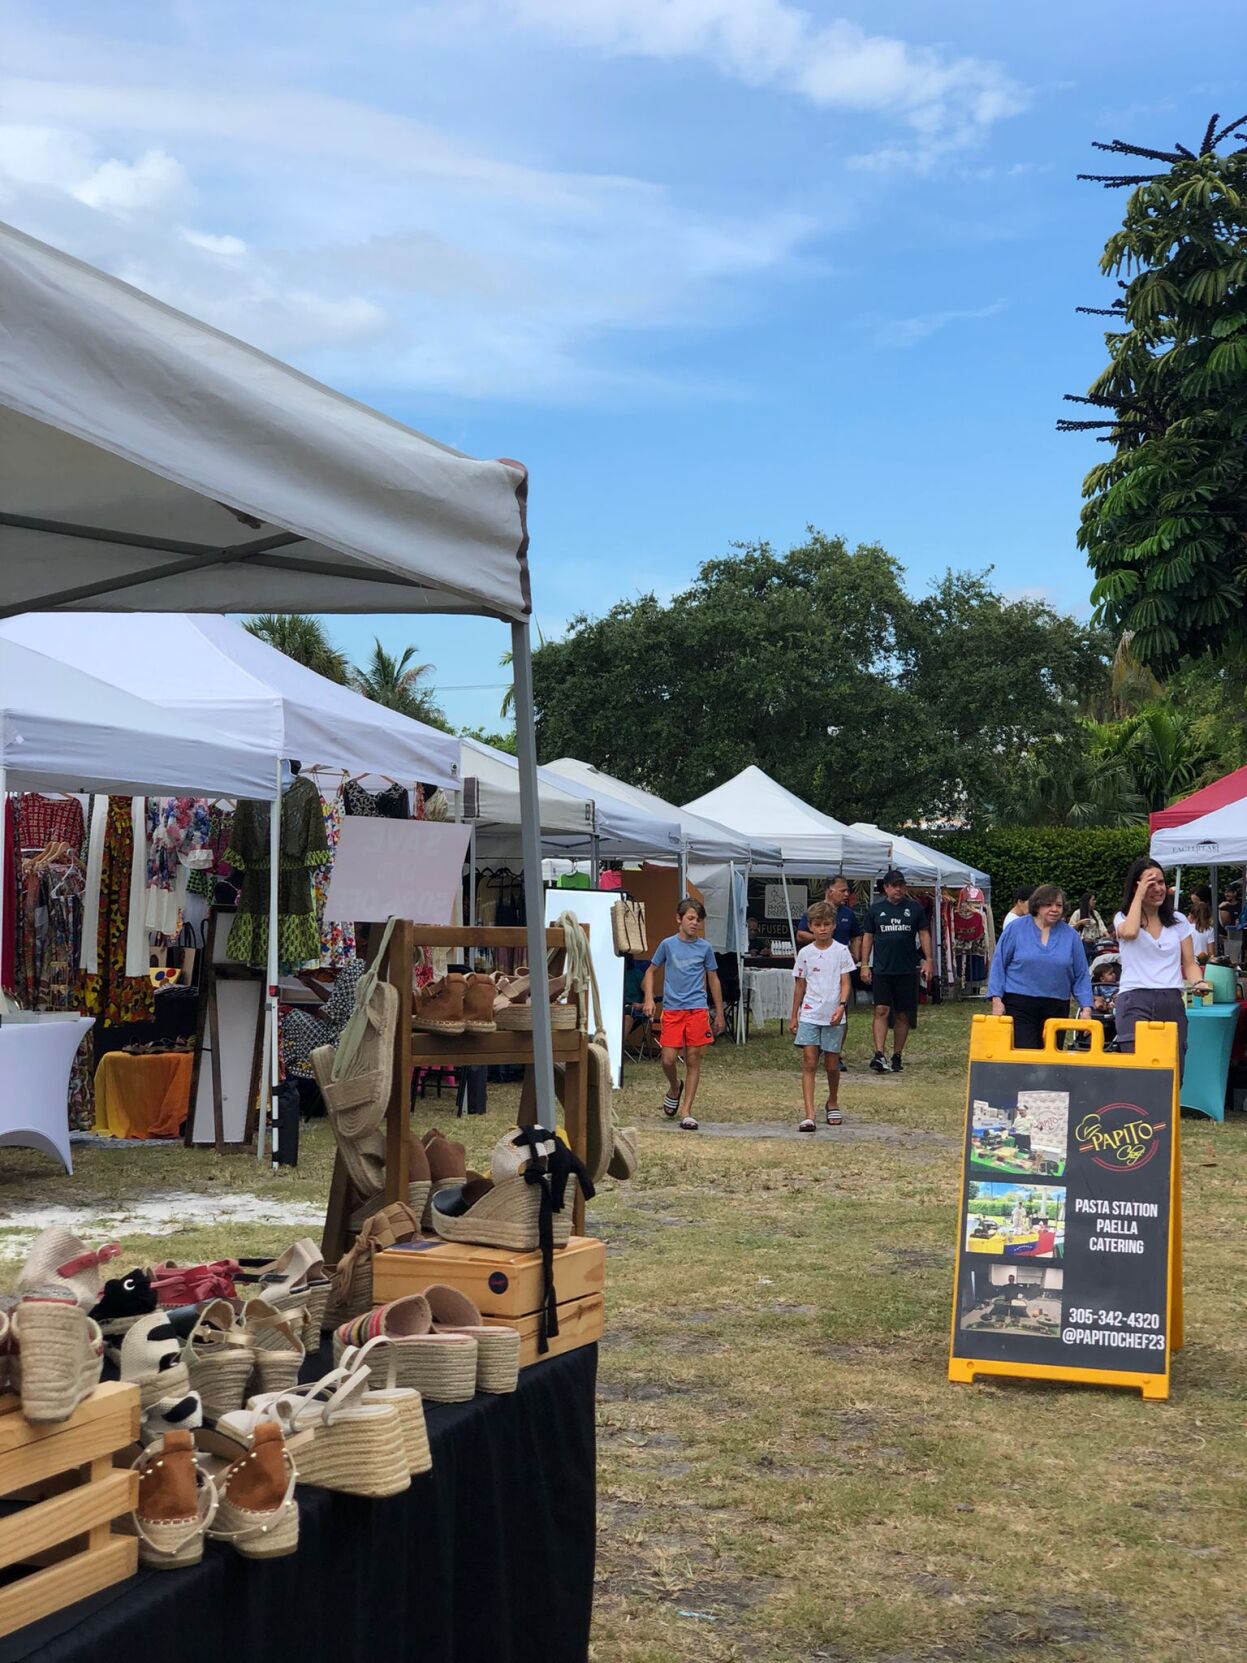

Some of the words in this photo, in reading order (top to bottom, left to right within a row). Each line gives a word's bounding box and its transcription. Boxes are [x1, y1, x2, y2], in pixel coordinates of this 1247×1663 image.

[880, 922, 911, 932] Emirates
[1092, 1120, 1153, 1151] PAPITO
[1075, 1198, 1110, 1214] PASTA
[1112, 1200, 1158, 1218] STATION
[1096, 1218, 1138, 1235] PAELLA
[1089, 1236, 1144, 1254] CATERING
[1069, 1307, 1160, 1329] 305-342-4320
[1062, 1327, 1165, 1350] @PAPITOCHEF23
